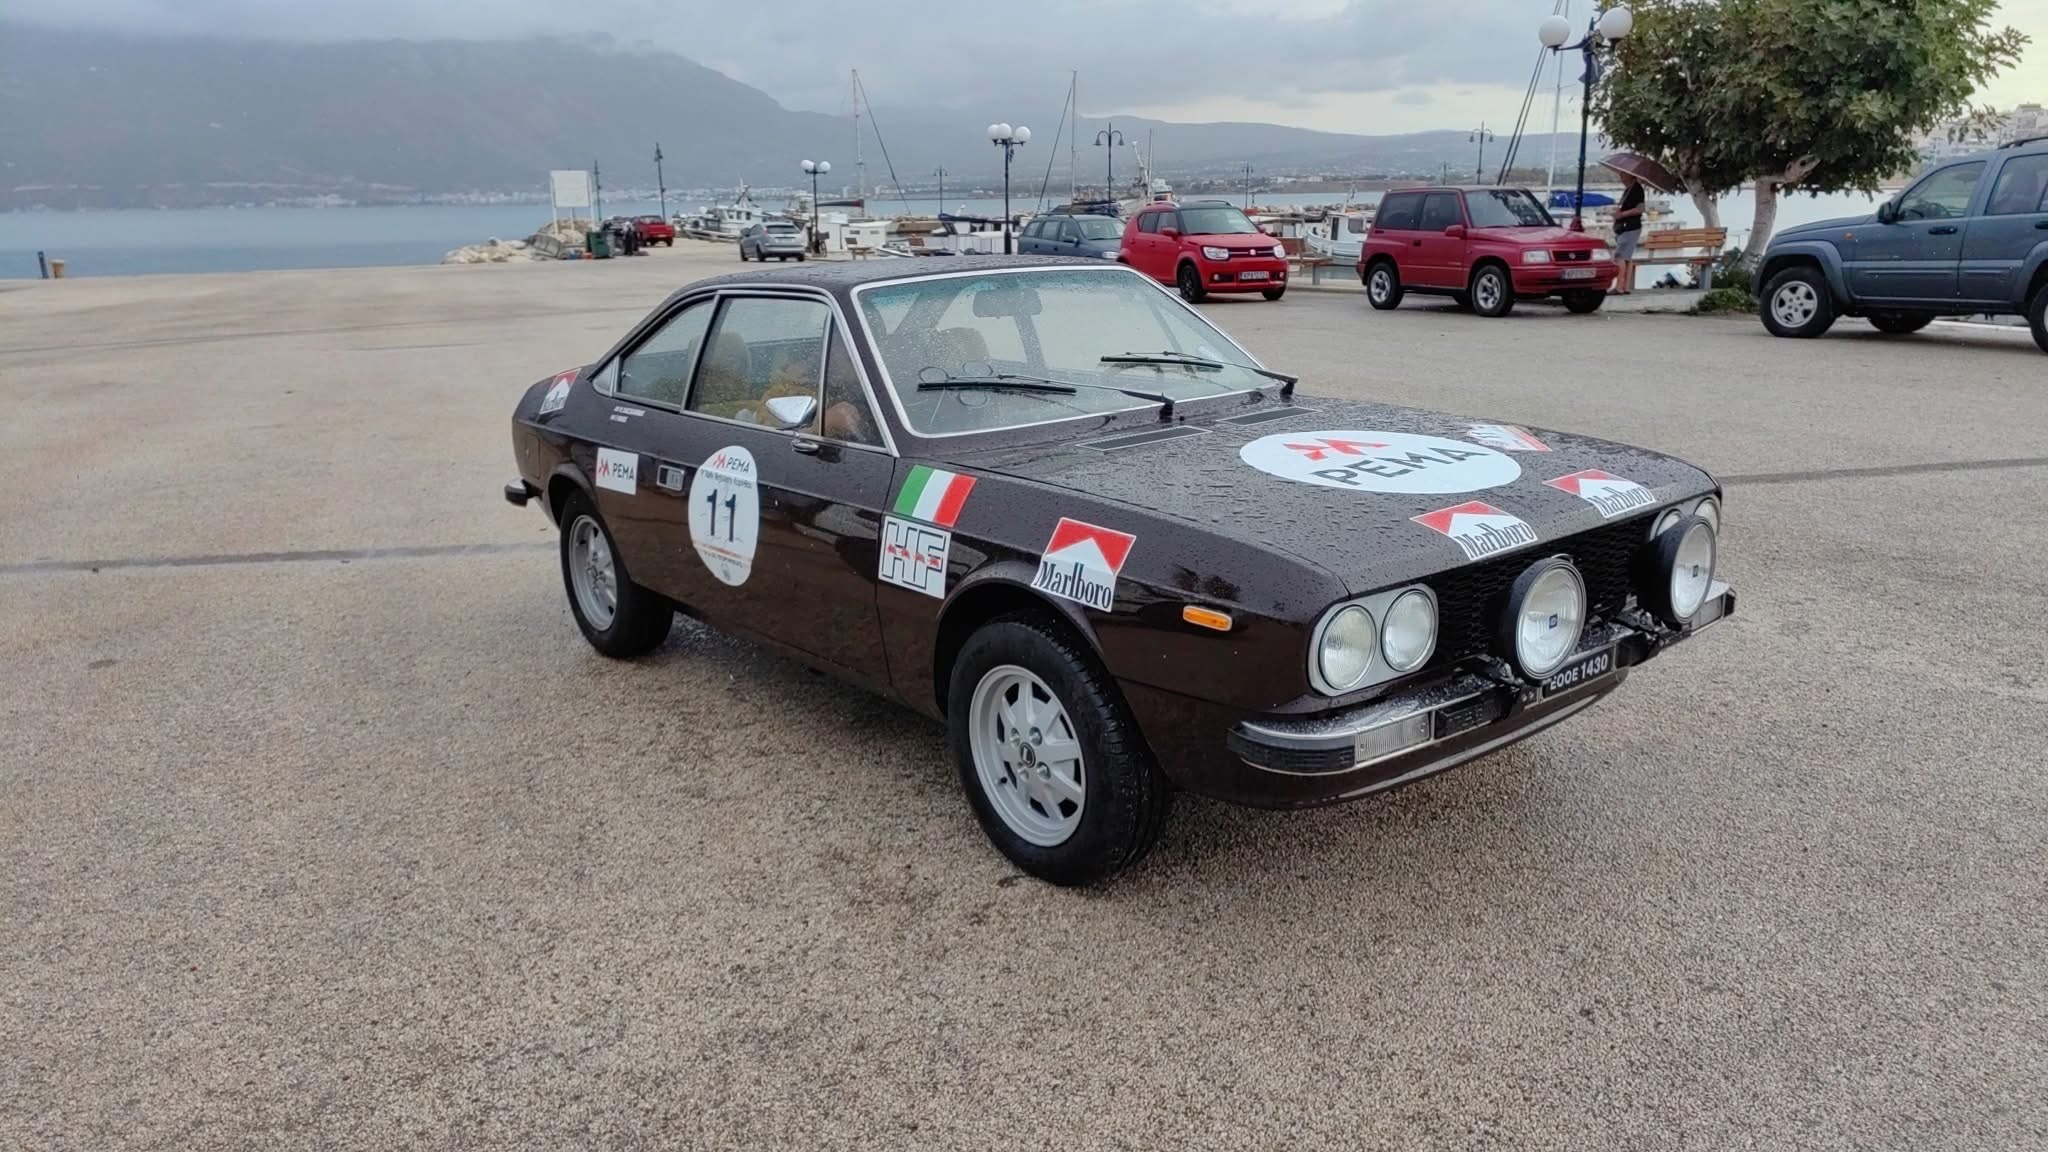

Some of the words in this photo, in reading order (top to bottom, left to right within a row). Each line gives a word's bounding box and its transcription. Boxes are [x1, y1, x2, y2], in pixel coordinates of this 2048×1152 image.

[612, 462, 635, 480] PEMA
[726, 456, 751, 473] PEMA
[1308, 446, 1491, 486] PEMA
[706, 488, 737, 542] 11
[1586, 486, 1655, 518] Marlboro
[881, 520, 947, 591] HF
[1453, 522, 1537, 560] Marlboro
[1034, 560, 1113, 609] Marlboro
[1581, 653, 1609, 679] 1430
